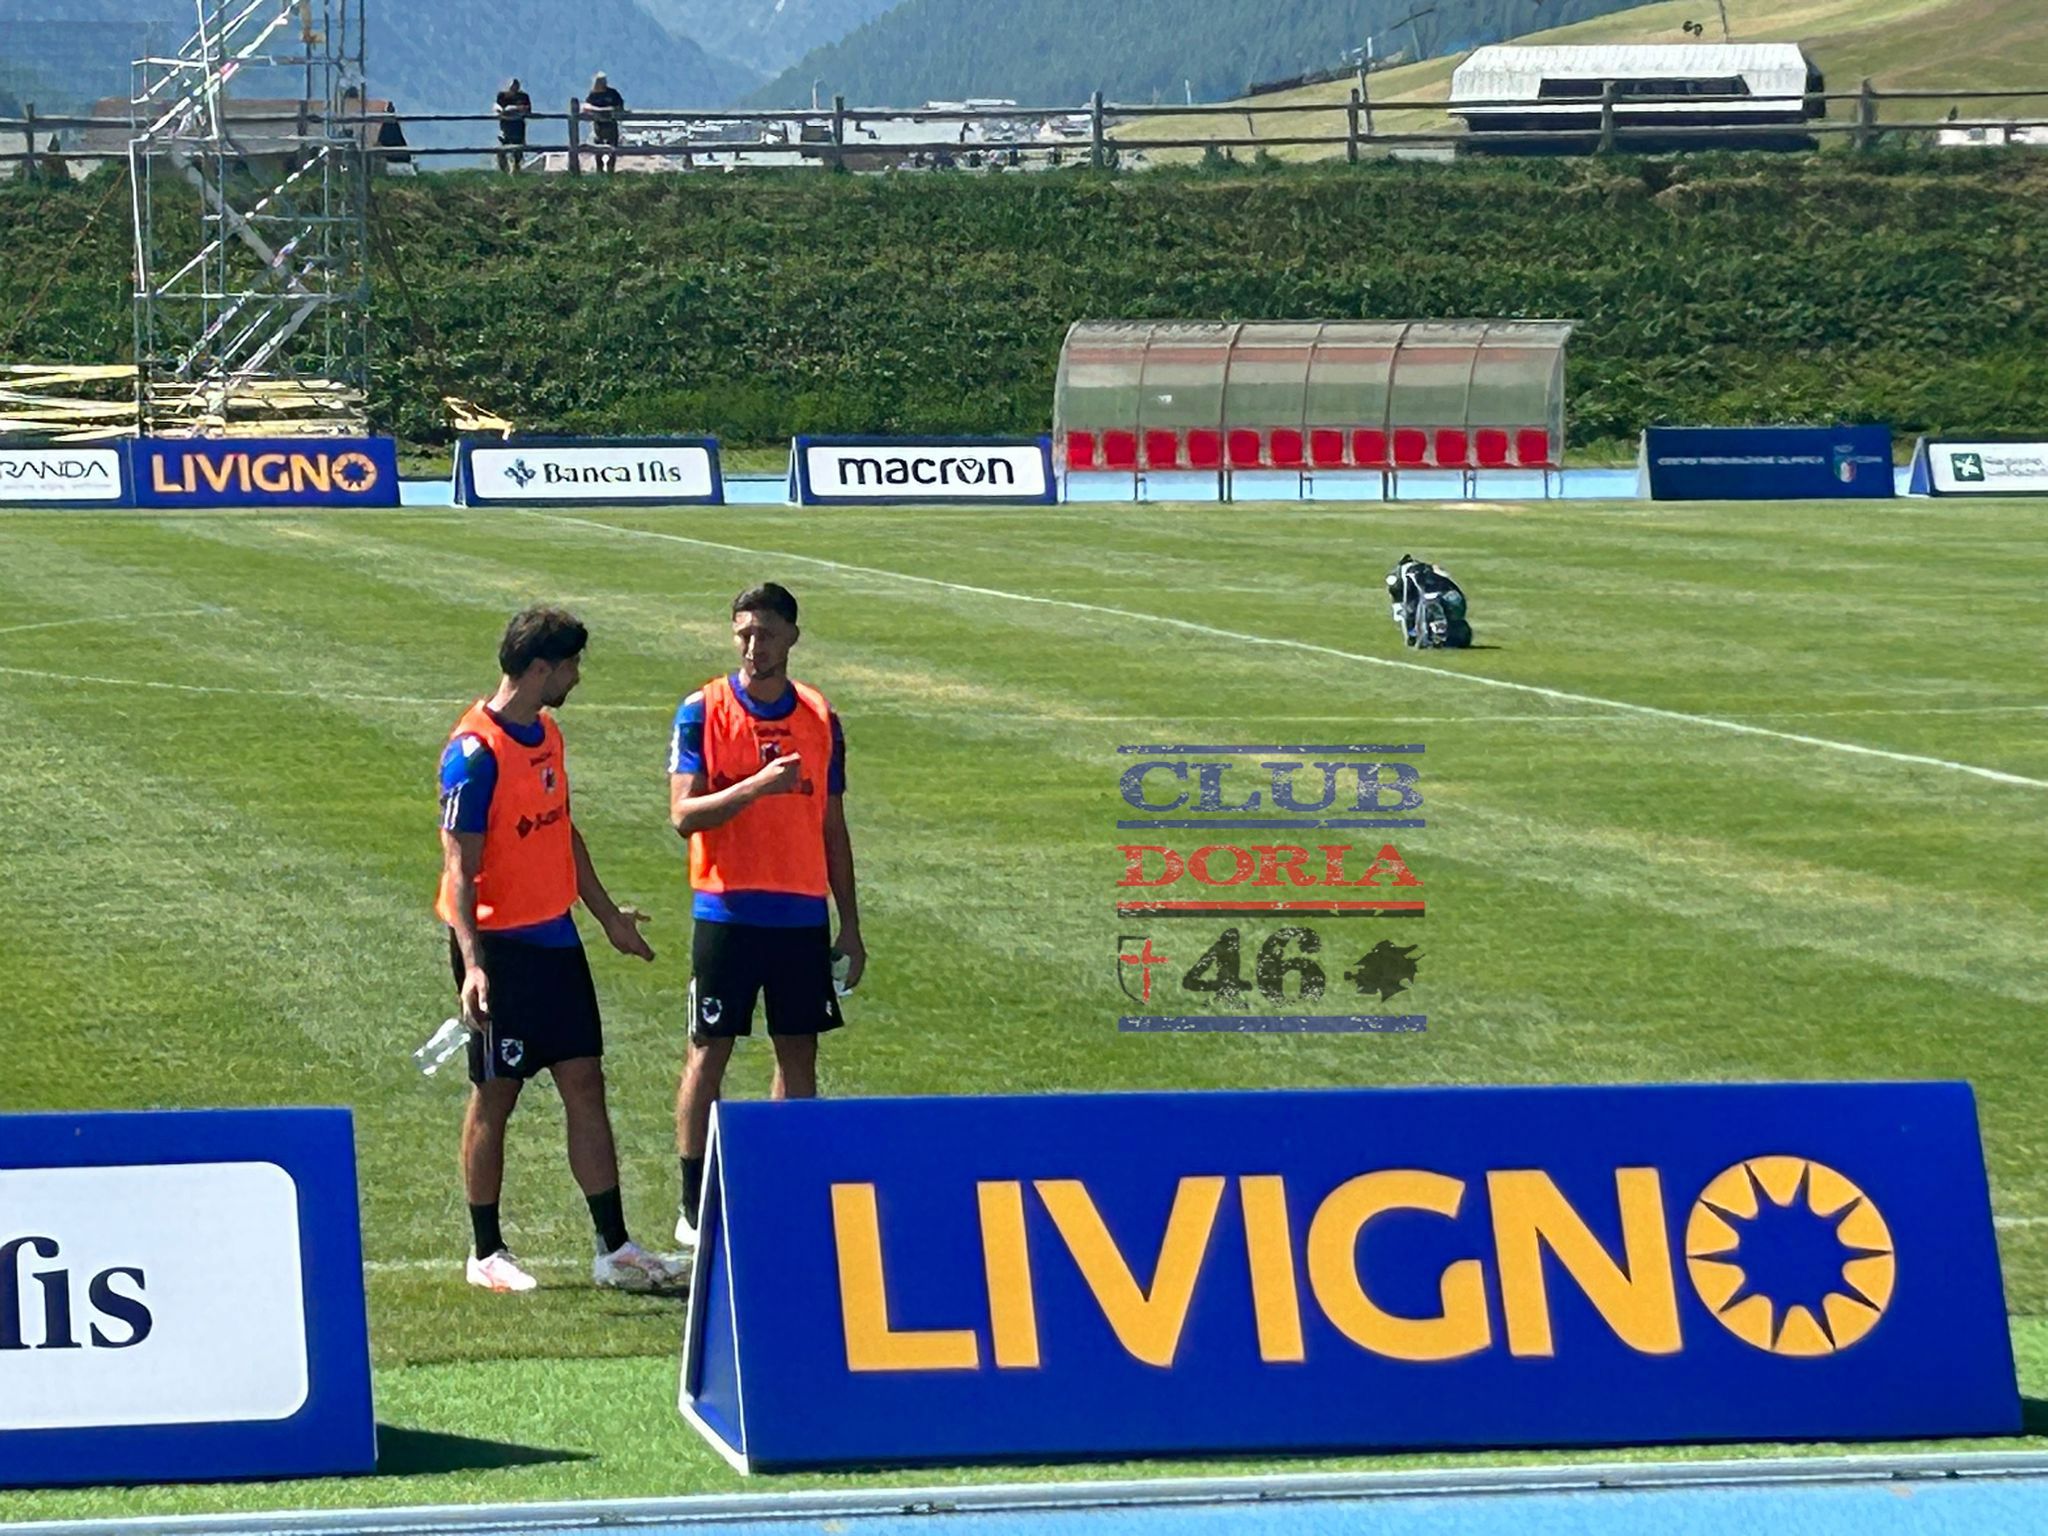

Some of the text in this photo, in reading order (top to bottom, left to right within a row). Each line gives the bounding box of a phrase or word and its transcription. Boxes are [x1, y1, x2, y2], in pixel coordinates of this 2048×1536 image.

[151, 452, 379, 493] LIVIGNO
[544, 462, 631, 483] Banca
[838, 457, 1014, 485] macron
[831, 1155, 1897, 1370] LIVIGNO
